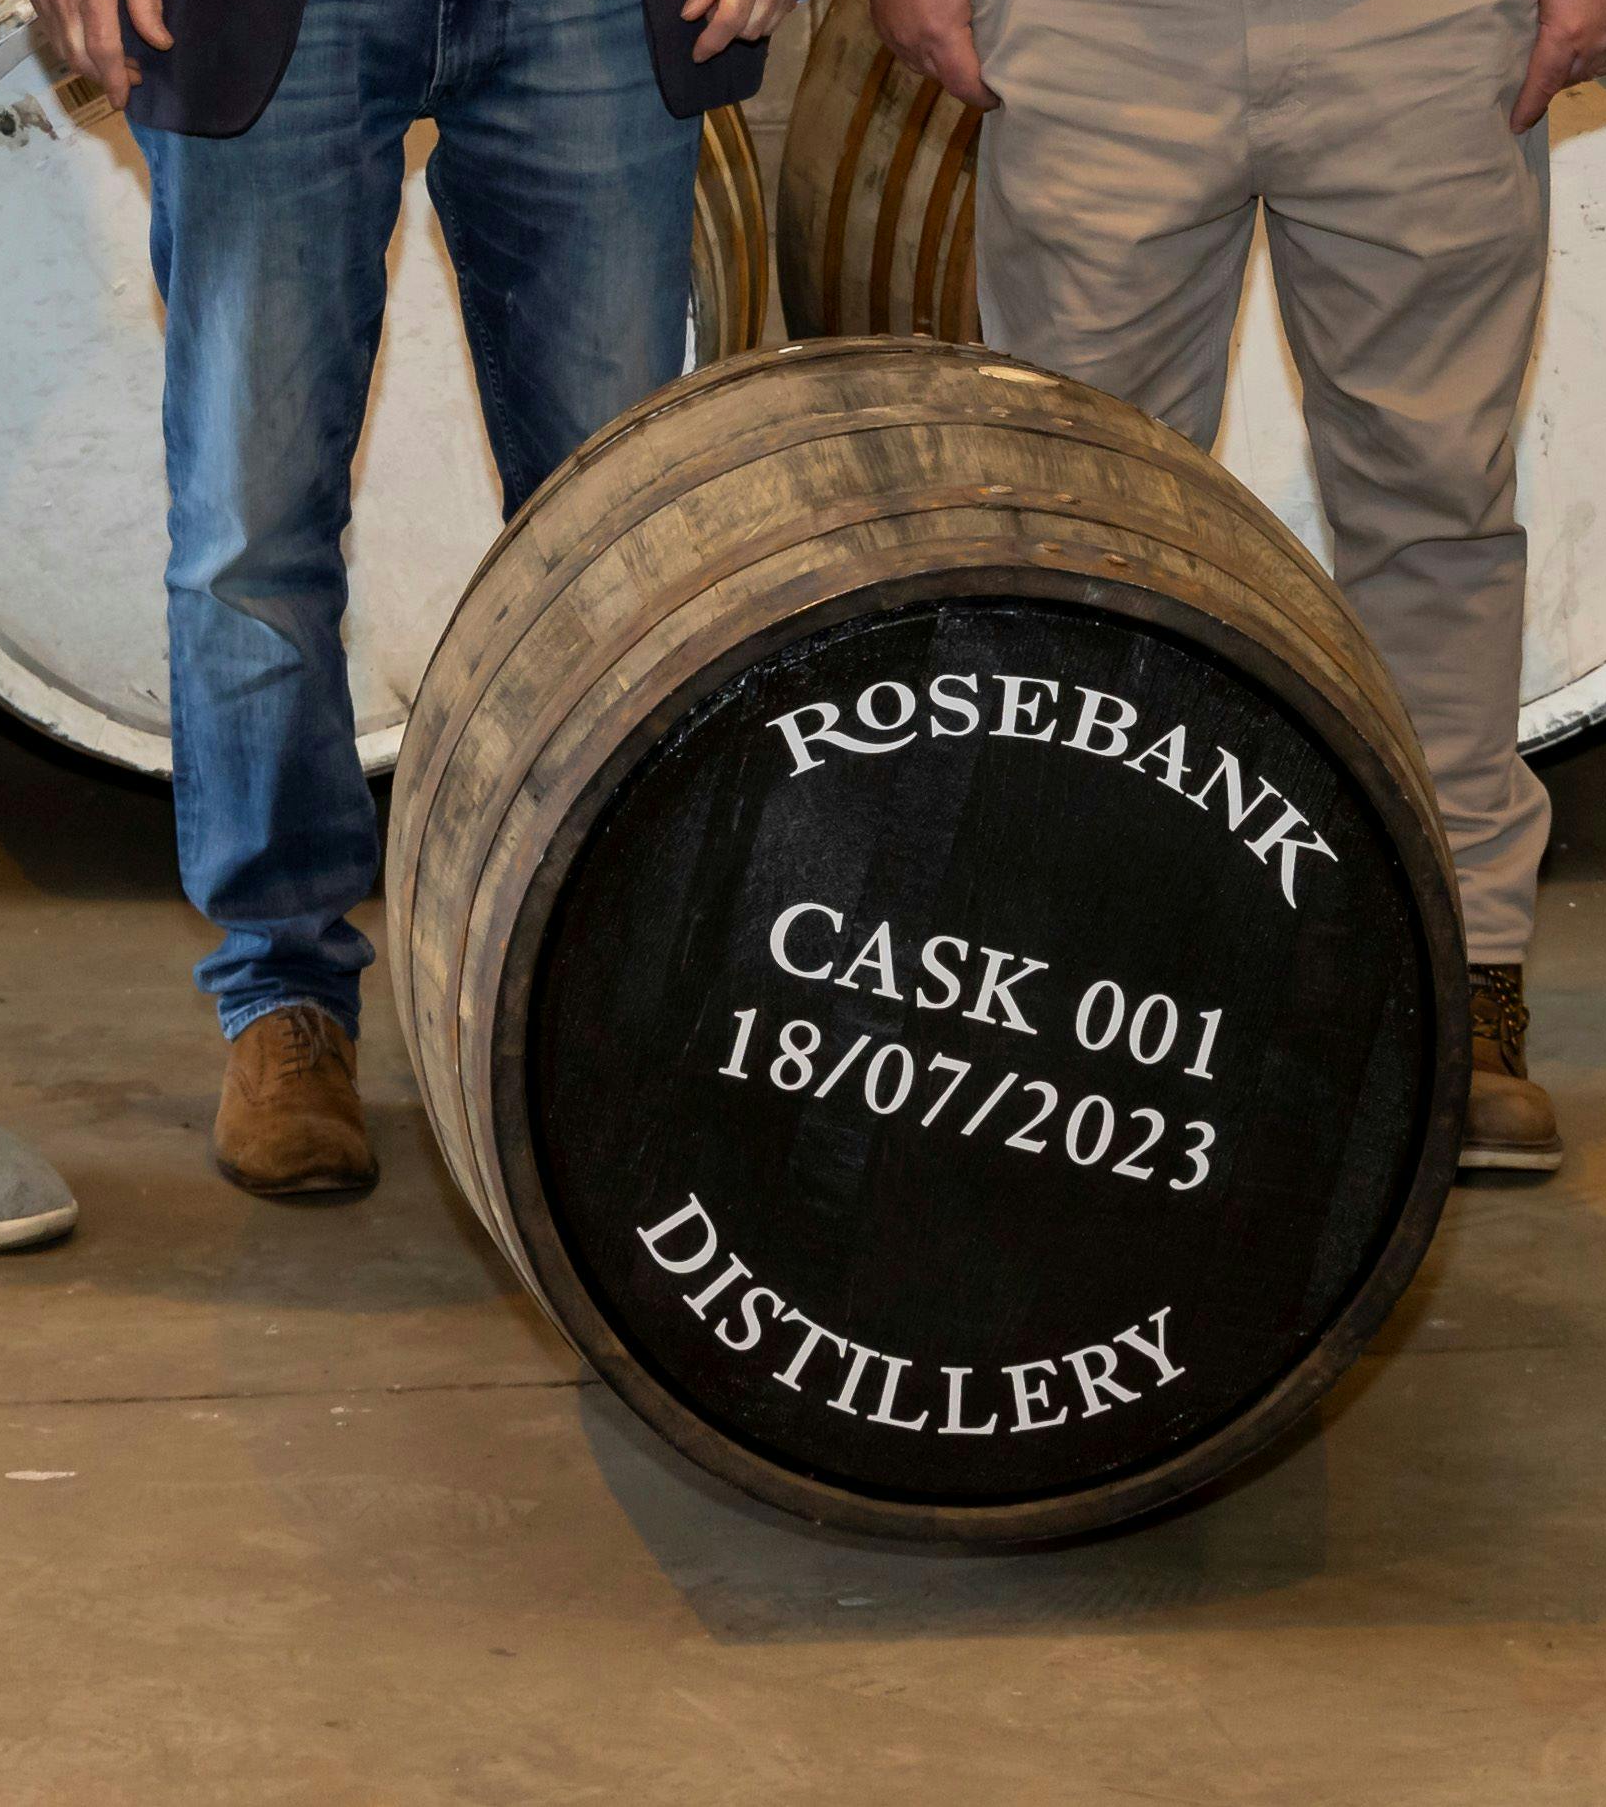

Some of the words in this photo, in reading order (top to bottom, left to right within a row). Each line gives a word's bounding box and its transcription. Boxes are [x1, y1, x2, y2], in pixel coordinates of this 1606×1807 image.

[765, 673, 1339, 910] ROSEBANK
[768, 901, 1050, 1036] CASK
[1074, 979, 1225, 1081] 001
[717, 1006, 1217, 1193] 18/07/2023
[636, 1191, 1187, 1436] DISTILLERY
